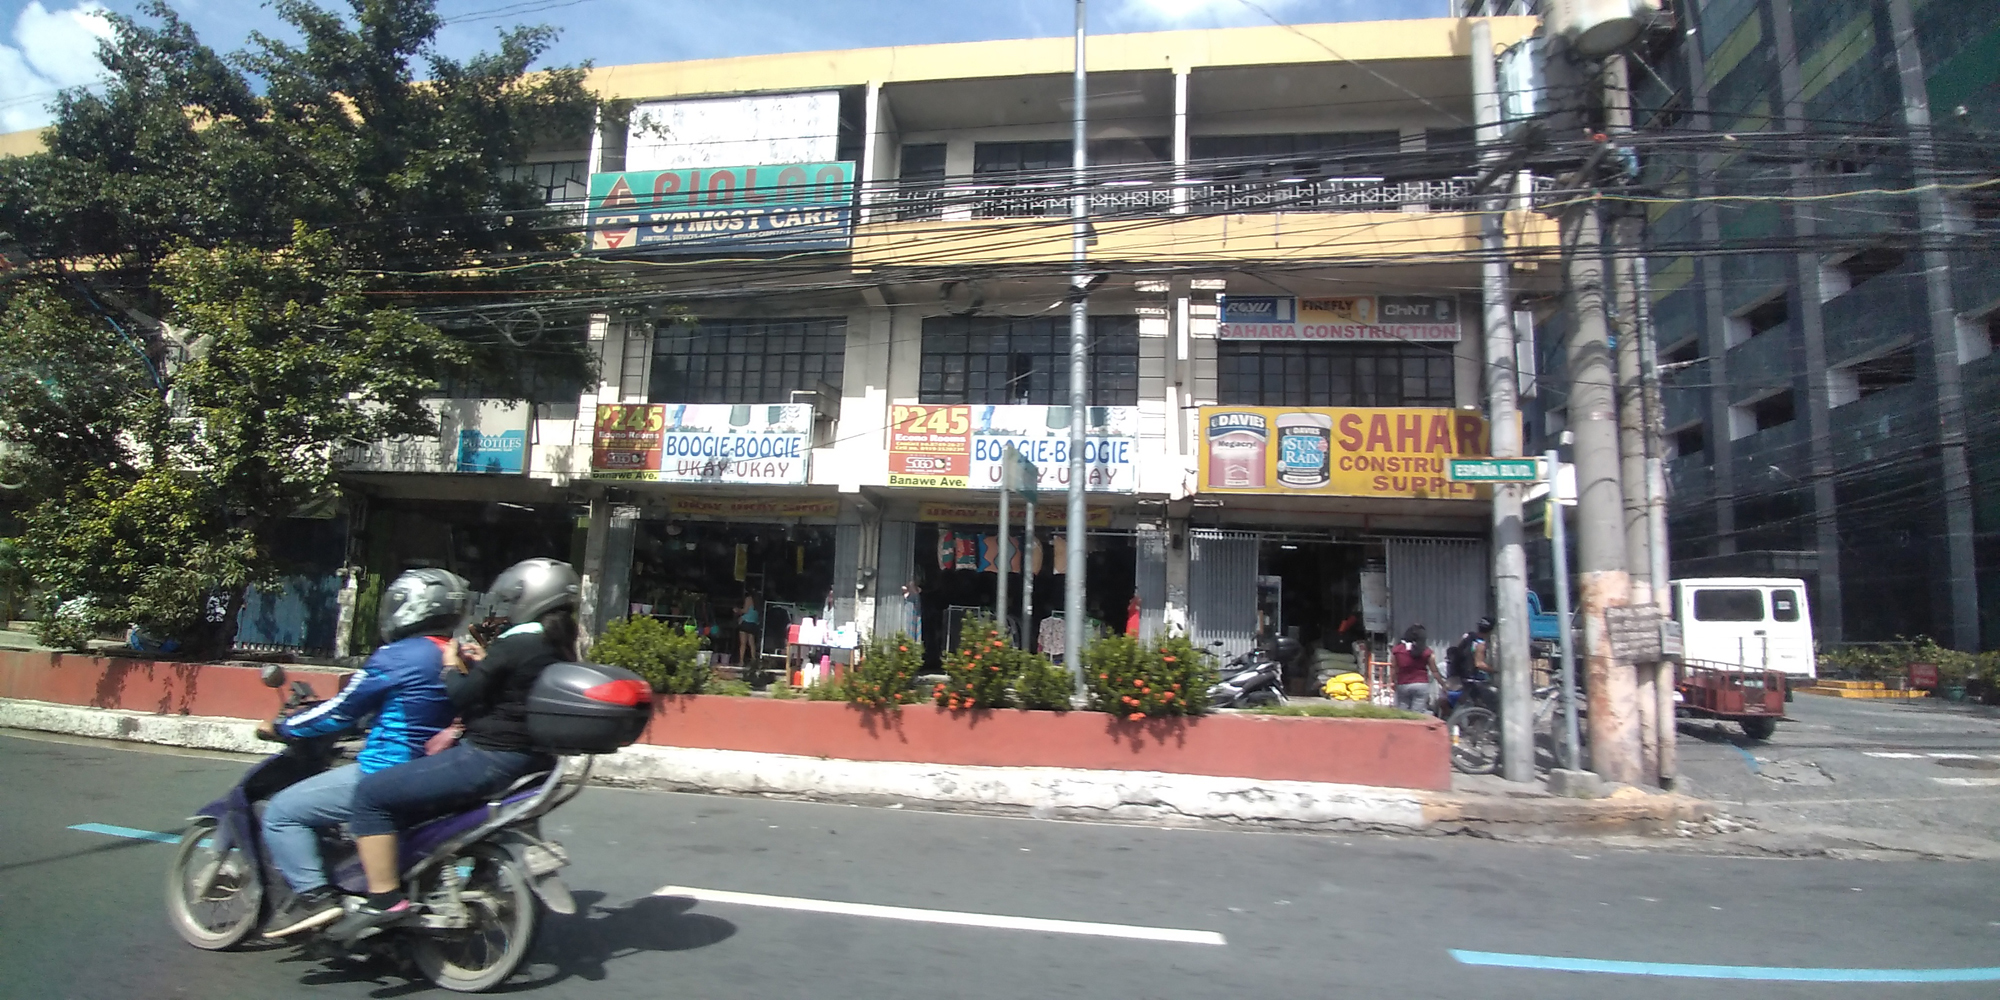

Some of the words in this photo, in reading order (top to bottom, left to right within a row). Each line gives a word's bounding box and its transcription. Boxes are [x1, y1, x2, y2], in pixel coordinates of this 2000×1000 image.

[651, 209, 760, 234] UTMOST
[769, 206, 840, 229] CARE
[1302, 300, 1351, 311] FIREFLY
[1220, 325, 1297, 339] SAHARA
[1303, 325, 1457, 339] CONSTRUCTION
[1219, 414, 1265, 428] DAVIES
[629, 431, 660, 439] Rooms
[895, 433, 928, 442] Econo
[929, 434, 967, 443] Rooms
[1293, 427, 1321, 435] DAVIES
[1338, 413, 1490, 455] SAHAR
[666, 435, 802, 458] BOOGIE-BOOGIE
[975, 439, 1130, 463] BOGIE-BOGIE
[1287, 438, 1317, 451] SUN
[1286, 451, 1320, 464] RAIN
[1339, 455, 1444, 473] CONSTRU
[592, 470, 633, 480] Banawe
[635, 472, 658, 480] Ave.
[677, 460, 790, 478] UKAY-UKAY
[989, 465, 1117, 484] UY-UAY
[1454, 462, 1500, 477] ESPAÑA
[1501, 464, 1534, 477] BLVD.
[890, 475, 937, 486] Banawe
[940, 477, 966, 487] Ave.
